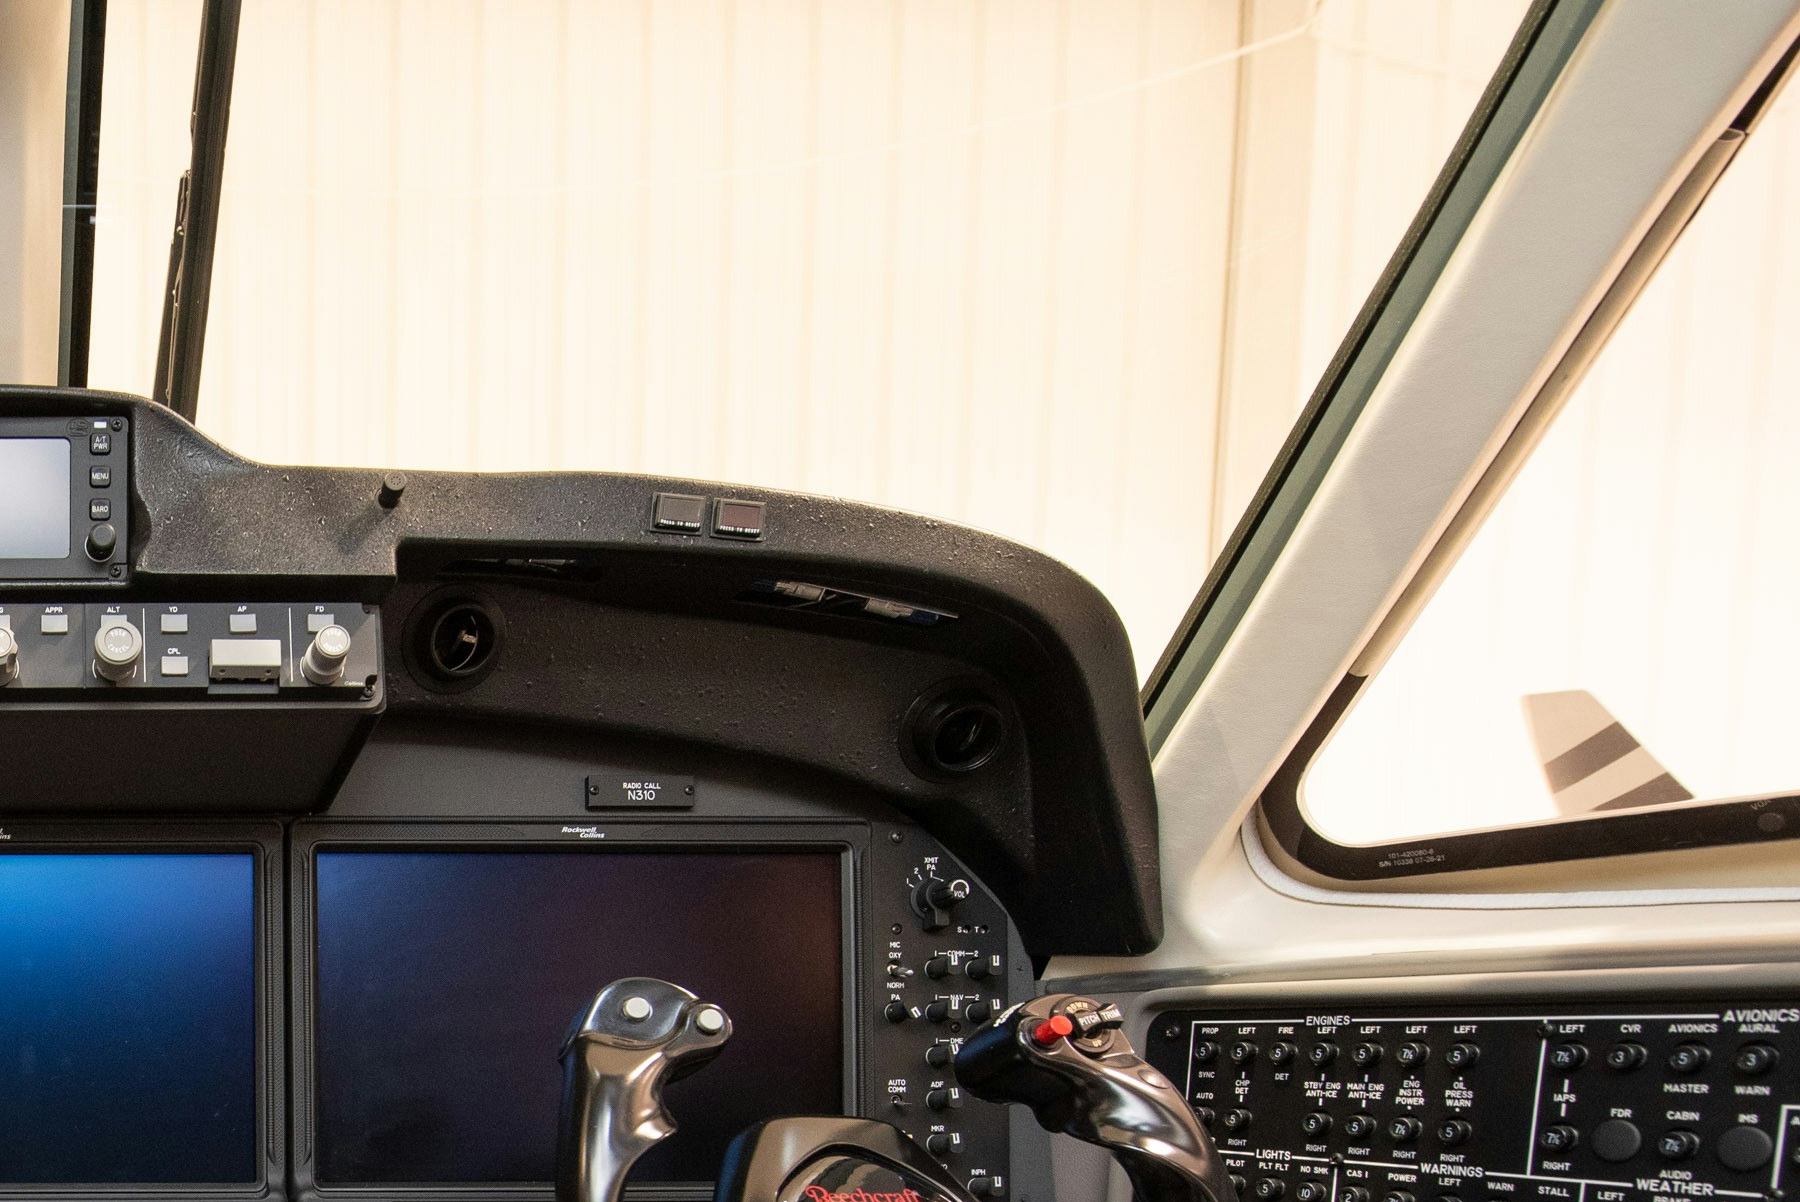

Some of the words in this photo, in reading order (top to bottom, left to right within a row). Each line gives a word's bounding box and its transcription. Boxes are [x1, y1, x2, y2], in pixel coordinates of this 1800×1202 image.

[628, 790, 655, 800] N310
[1066, 1002, 1088, 1013] DOWN
[1079, 1013, 1100, 1026] PITCH
[1102, 1009, 1120, 1020] TRIM
[1306, 1016, 1350, 1025] ENGINES
[1722, 1009, 1800, 1023] AVIONICS
[1256, 1150, 1290, 1160] LIGHTS
[1421, 1163, 1483, 1177] WARNINGS
[1636, 1179, 1714, 1195] WEATHER
